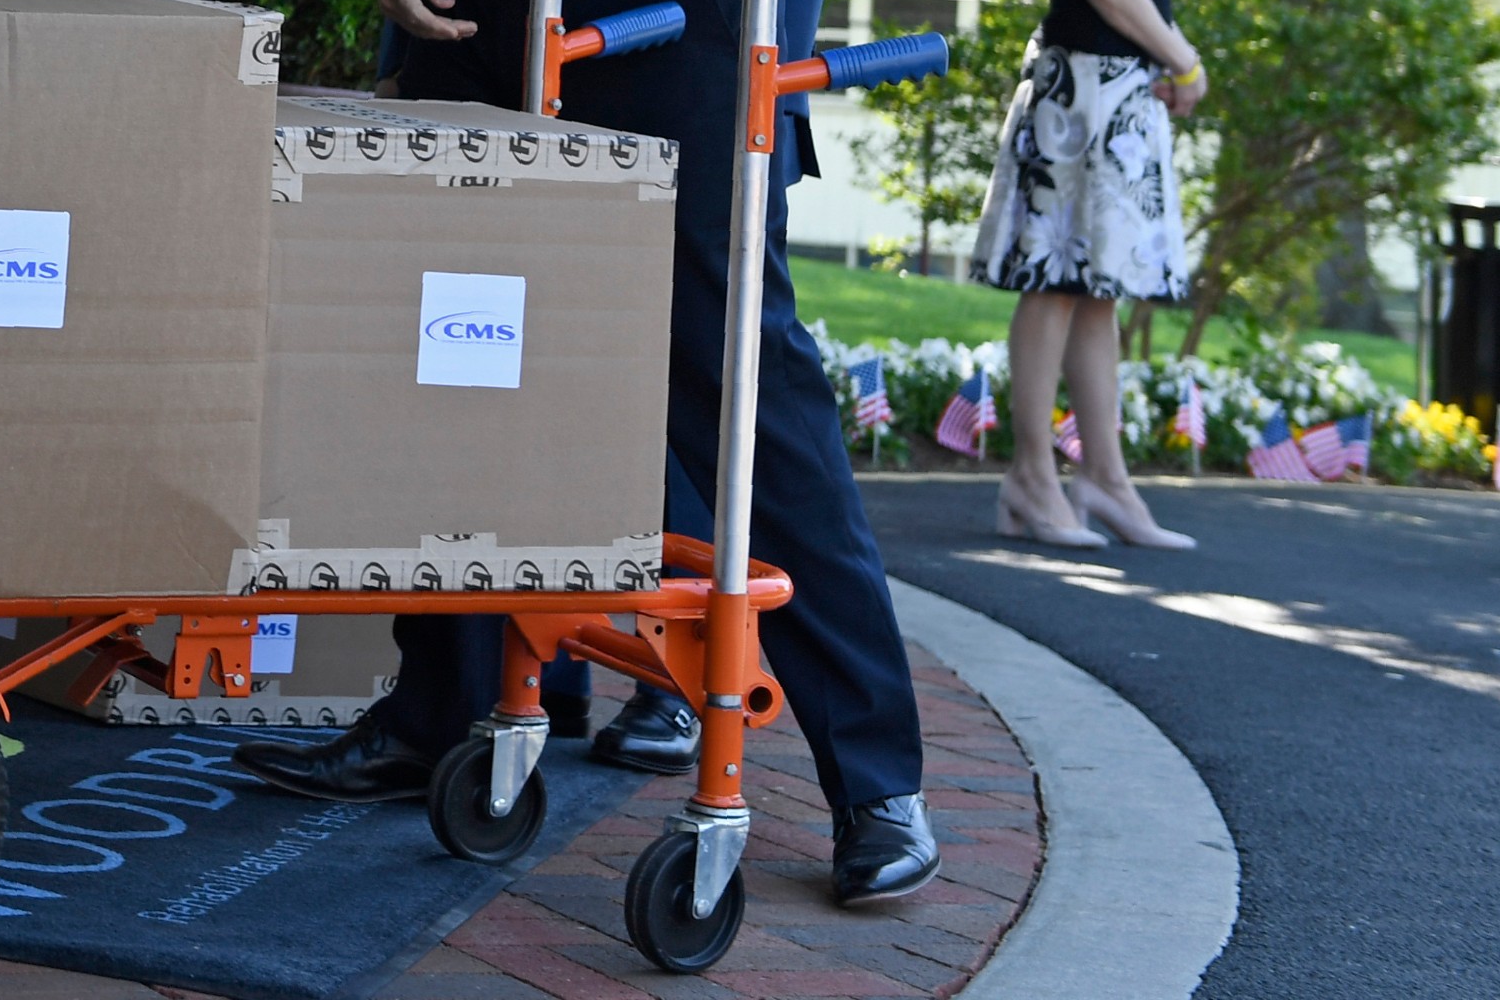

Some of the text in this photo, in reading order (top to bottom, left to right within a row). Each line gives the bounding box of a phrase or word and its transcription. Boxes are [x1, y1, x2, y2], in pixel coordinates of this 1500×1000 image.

[443, 322, 516, 341] CMS
[257, 622, 291, 636] MS
[137, 838, 314, 925] Rehabilitation
